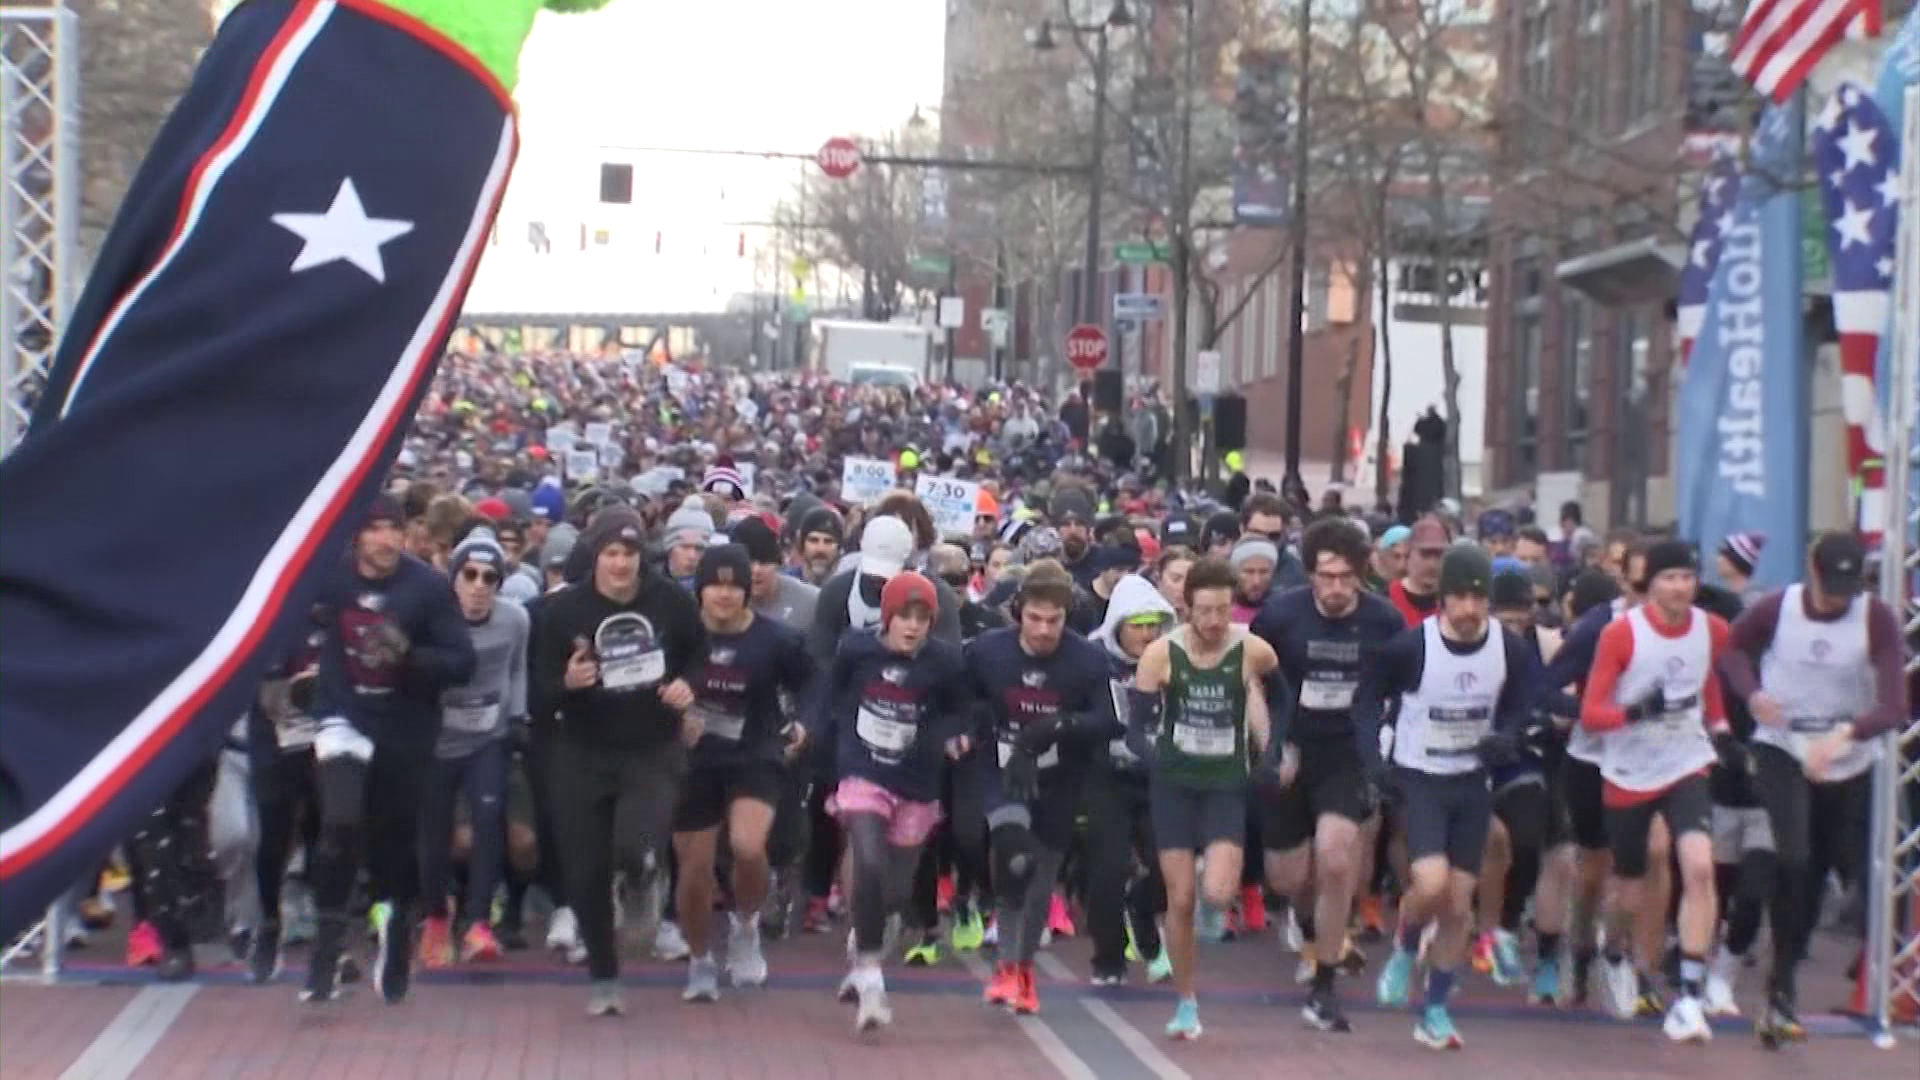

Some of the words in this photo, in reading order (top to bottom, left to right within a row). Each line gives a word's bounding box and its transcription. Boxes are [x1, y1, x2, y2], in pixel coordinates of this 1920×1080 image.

[820, 148, 857, 168] STOP
[1068, 339, 1106, 357] STOP
[927, 481, 966, 499] 7:30
